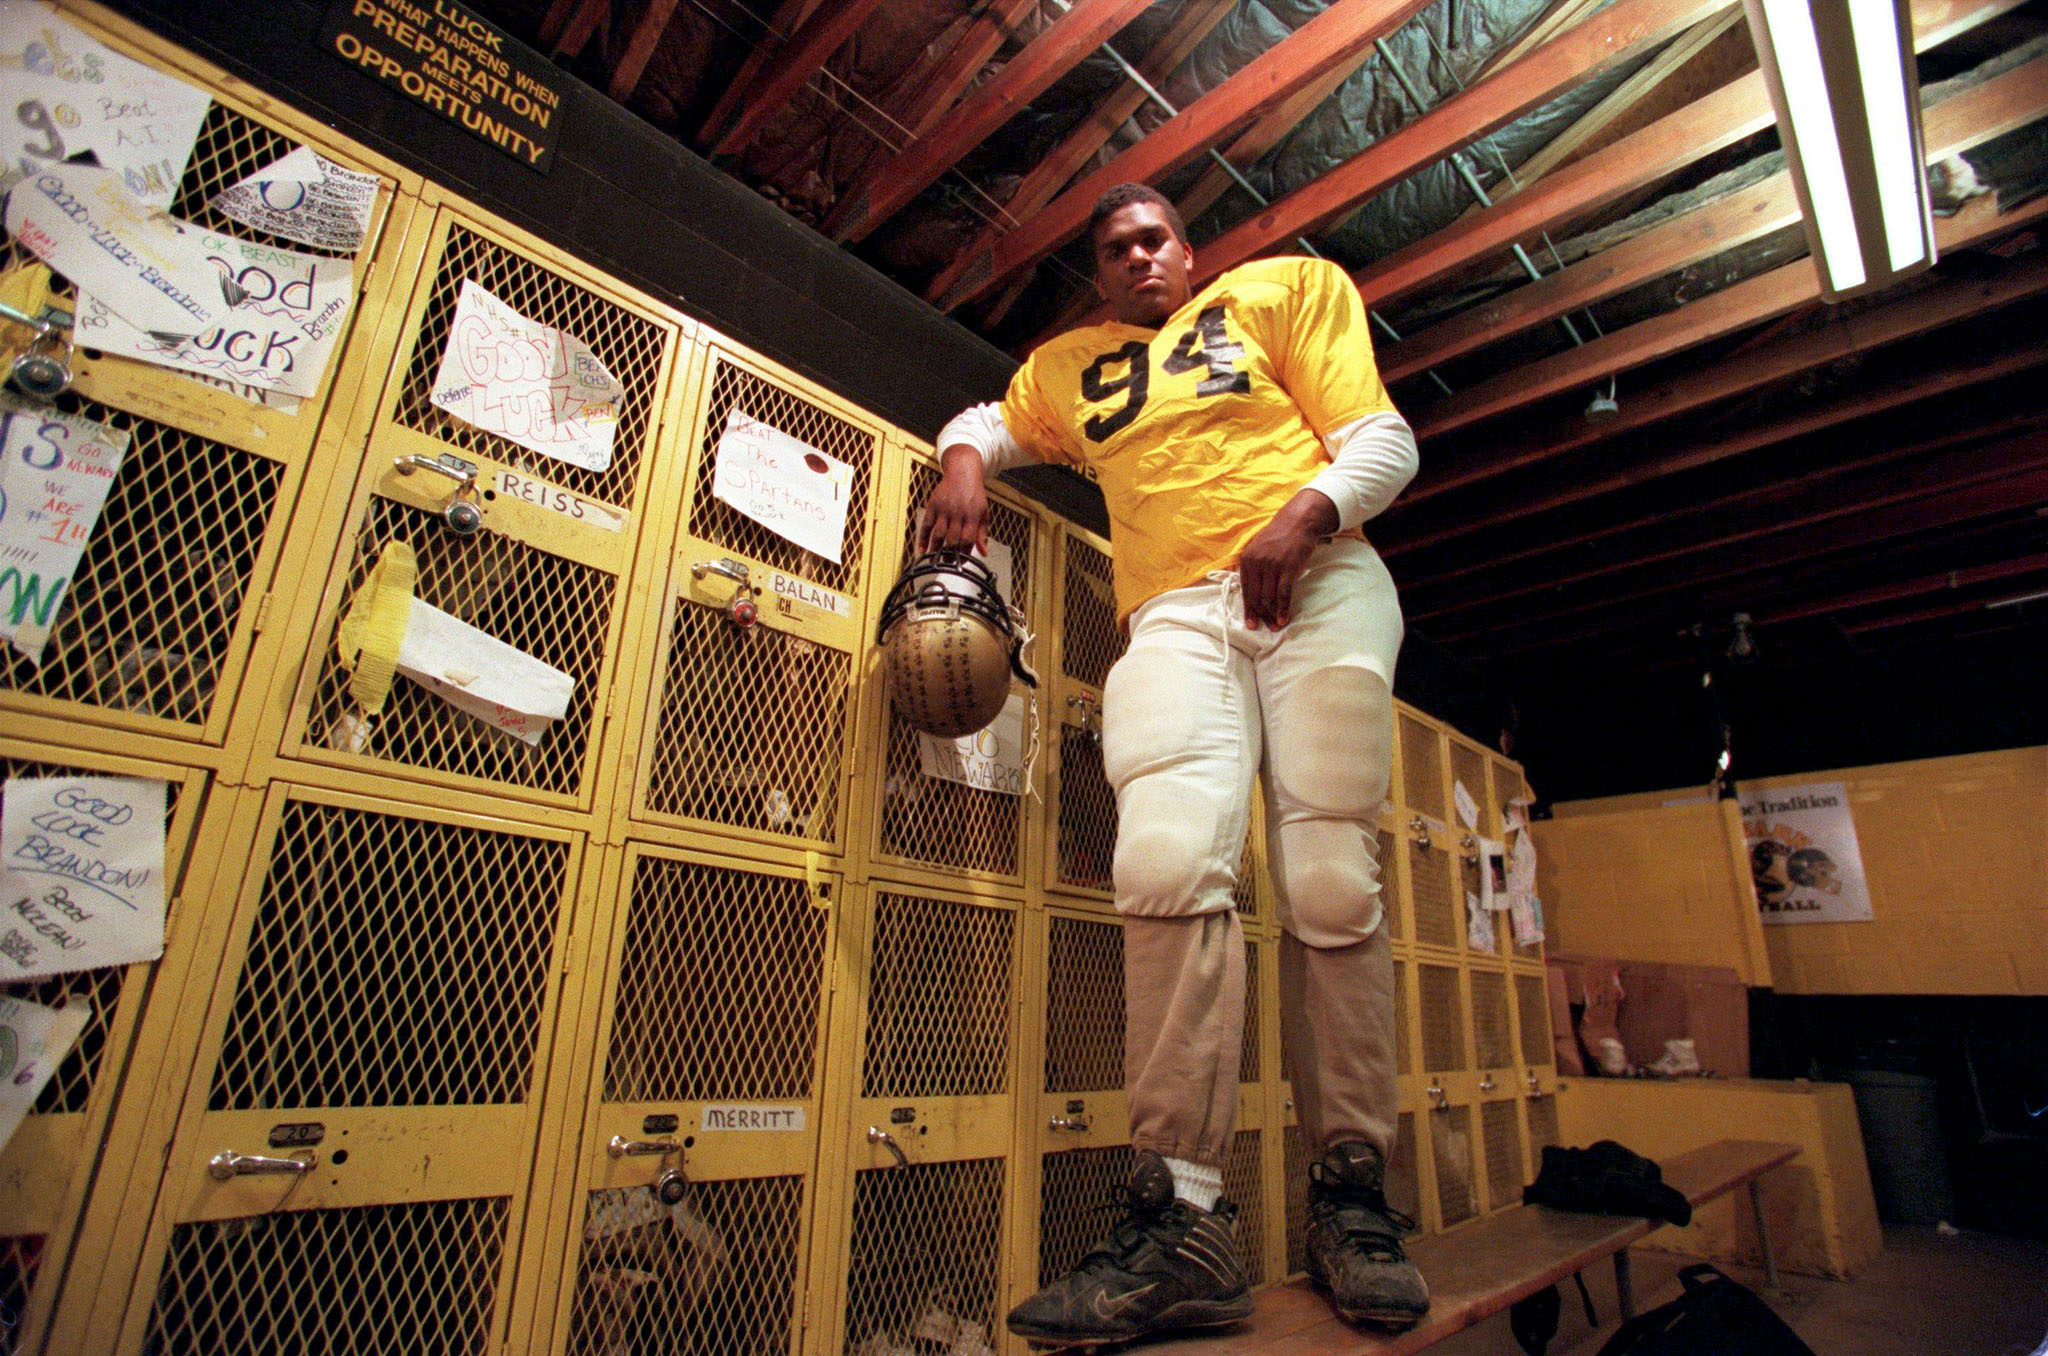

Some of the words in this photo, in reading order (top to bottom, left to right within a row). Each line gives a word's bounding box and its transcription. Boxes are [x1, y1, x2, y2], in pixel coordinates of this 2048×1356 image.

[435, 0, 503, 53] LUCK
[353, 0, 550, 129] PREPARATION
[384, 0, 432, 29] WHAT
[436, 23, 511, 78] HAPPENS
[515, 71, 560, 109] WHEN
[335, 33, 545, 164] OPPORTUNITY
[421, 61, 482, 104] MEETS
[1081, 304, 1251, 444] 94
[470, 383, 592, 443] LUCK
[42, 496, 84, 516] ARE
[502, 473, 585, 519] REISS
[774, 575, 836, 612] BALAN
[932, 742, 1020, 793] NEWARK
[1758, 795, 1839, 814] Tradition
[707, 1110, 795, 1128] MERRITT
